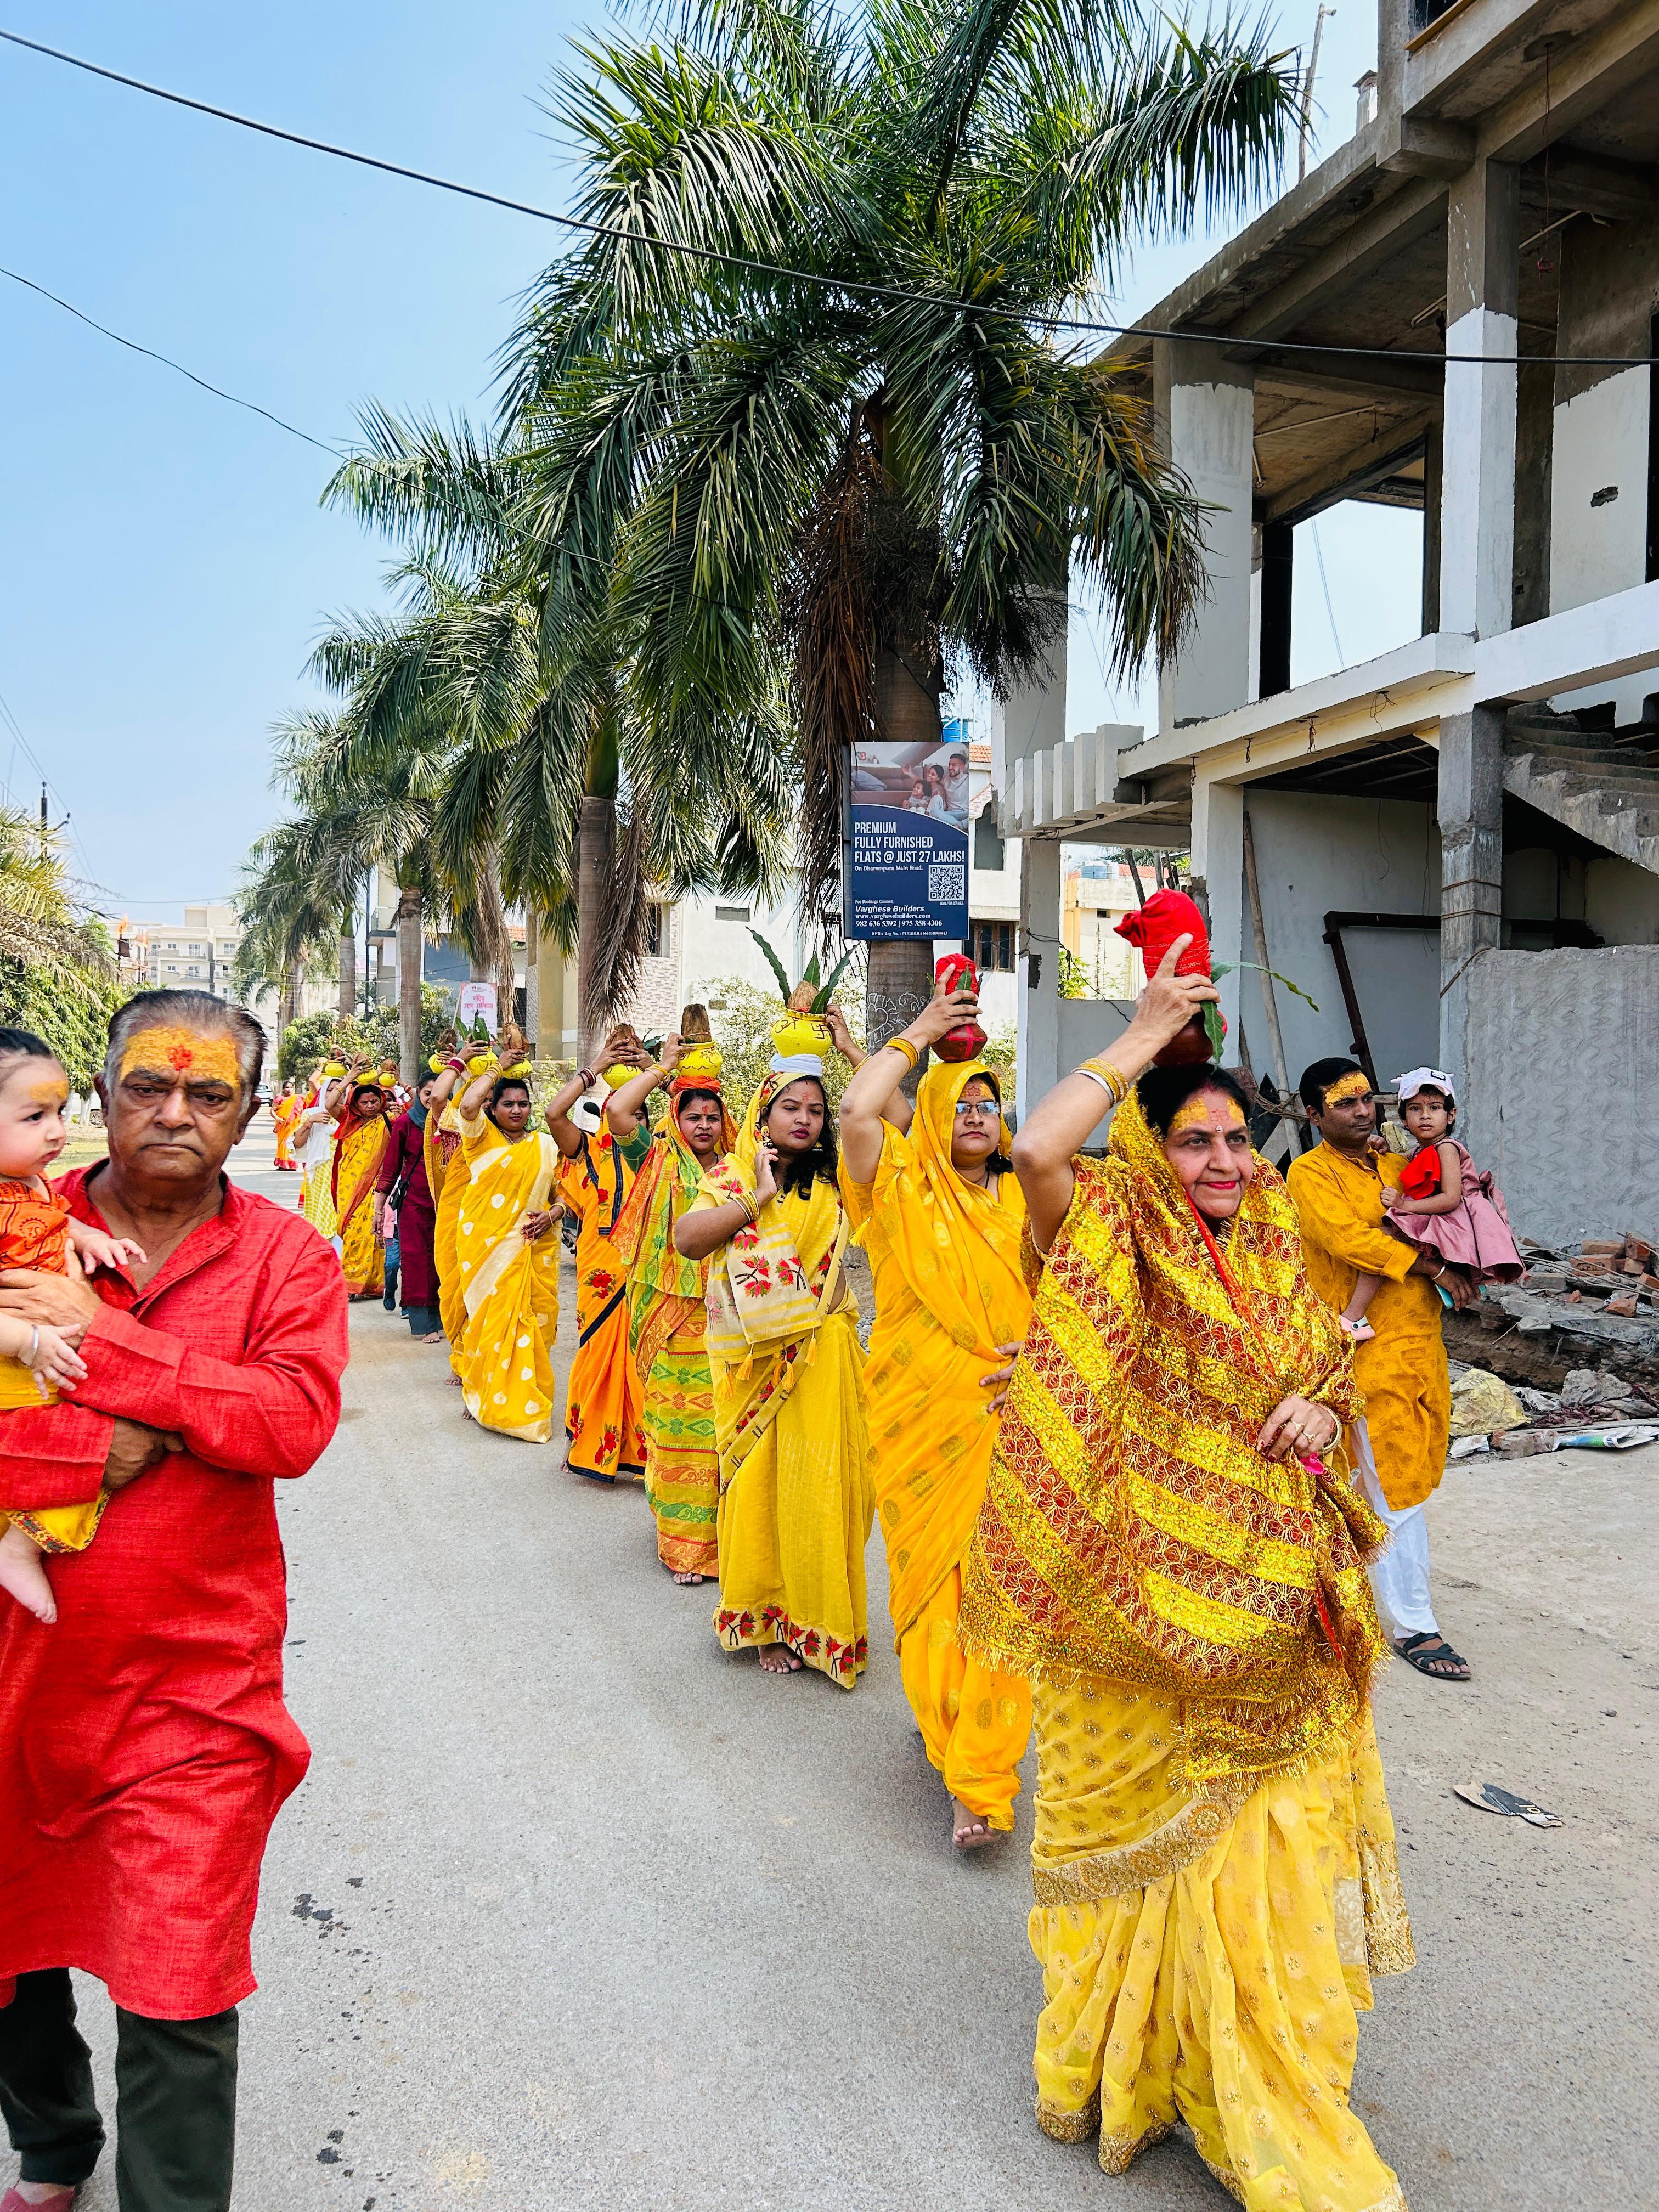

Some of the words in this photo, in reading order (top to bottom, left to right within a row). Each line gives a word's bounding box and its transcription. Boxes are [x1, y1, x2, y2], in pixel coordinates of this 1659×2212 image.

[854, 822, 896, 834] PREMIUM
[854, 837, 882, 848] FULLY
[883, 836, 933, 848] FURNISHED
[855, 851, 882, 863] FLATS
[883, 850, 894, 864] @
[895, 851, 917, 863] JUST
[918, 851, 931, 862] 27
[933, 850, 964, 862] LAKHS!
[855, 905, 891, 914] Varghese
